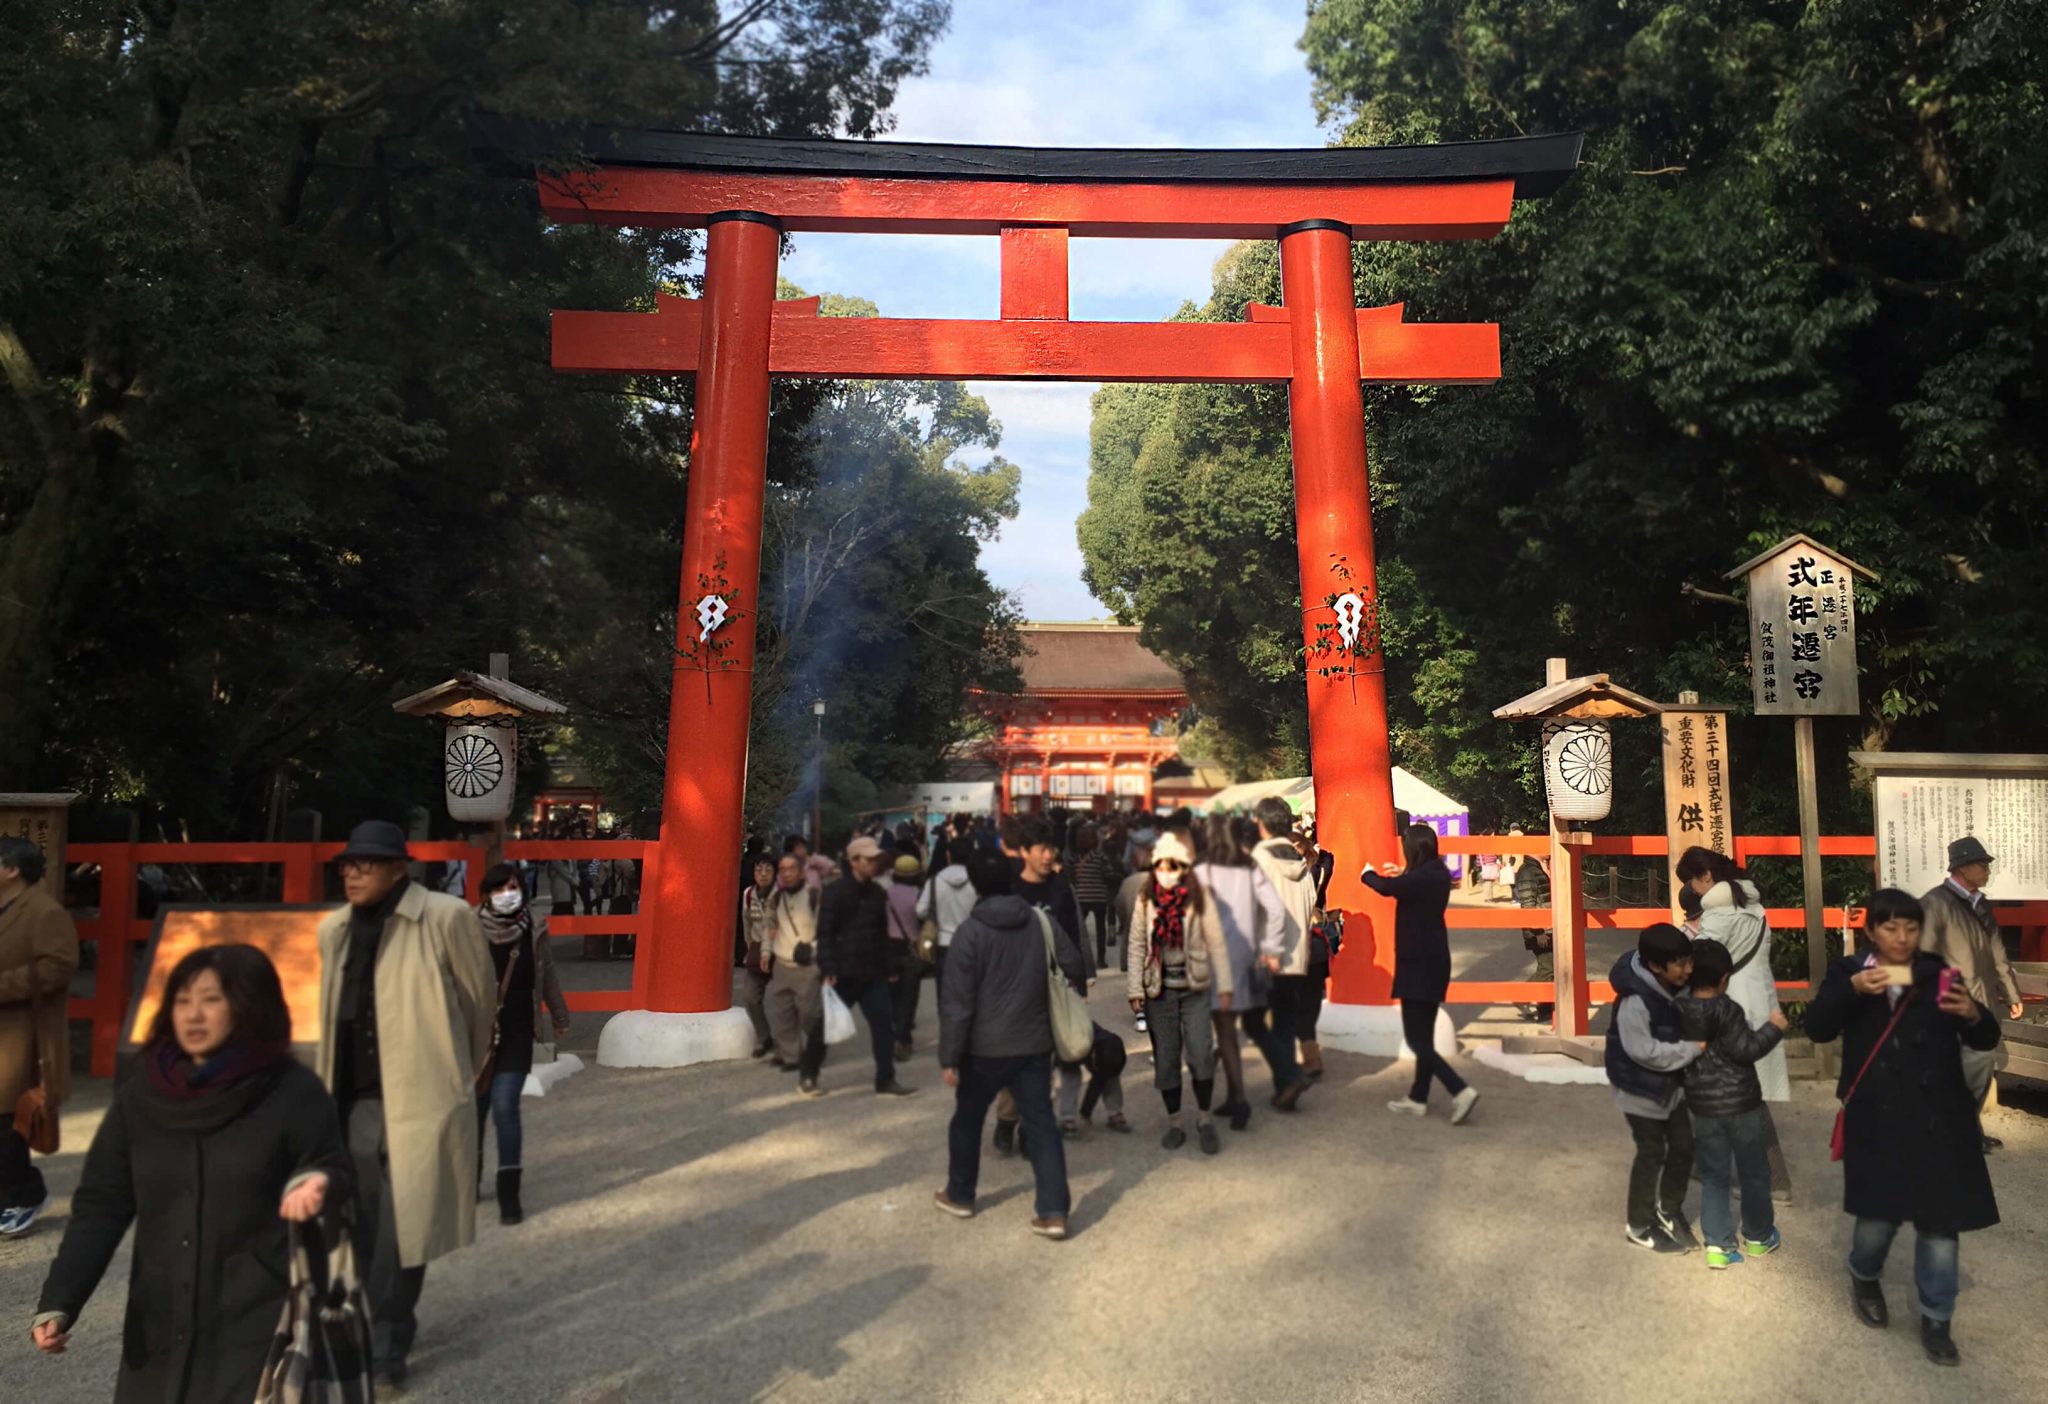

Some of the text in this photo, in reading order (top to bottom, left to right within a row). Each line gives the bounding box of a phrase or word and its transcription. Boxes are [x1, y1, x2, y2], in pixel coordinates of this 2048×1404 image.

[1788, 557, 1823, 700] 式年遷宮
[1820, 569, 1838, 641] 正遷宮
[1760, 620, 1777, 703] 賀茂御祖神社
[1677, 715, 1696, 789] 重要文化財
[1676, 802, 1704, 833] 供
